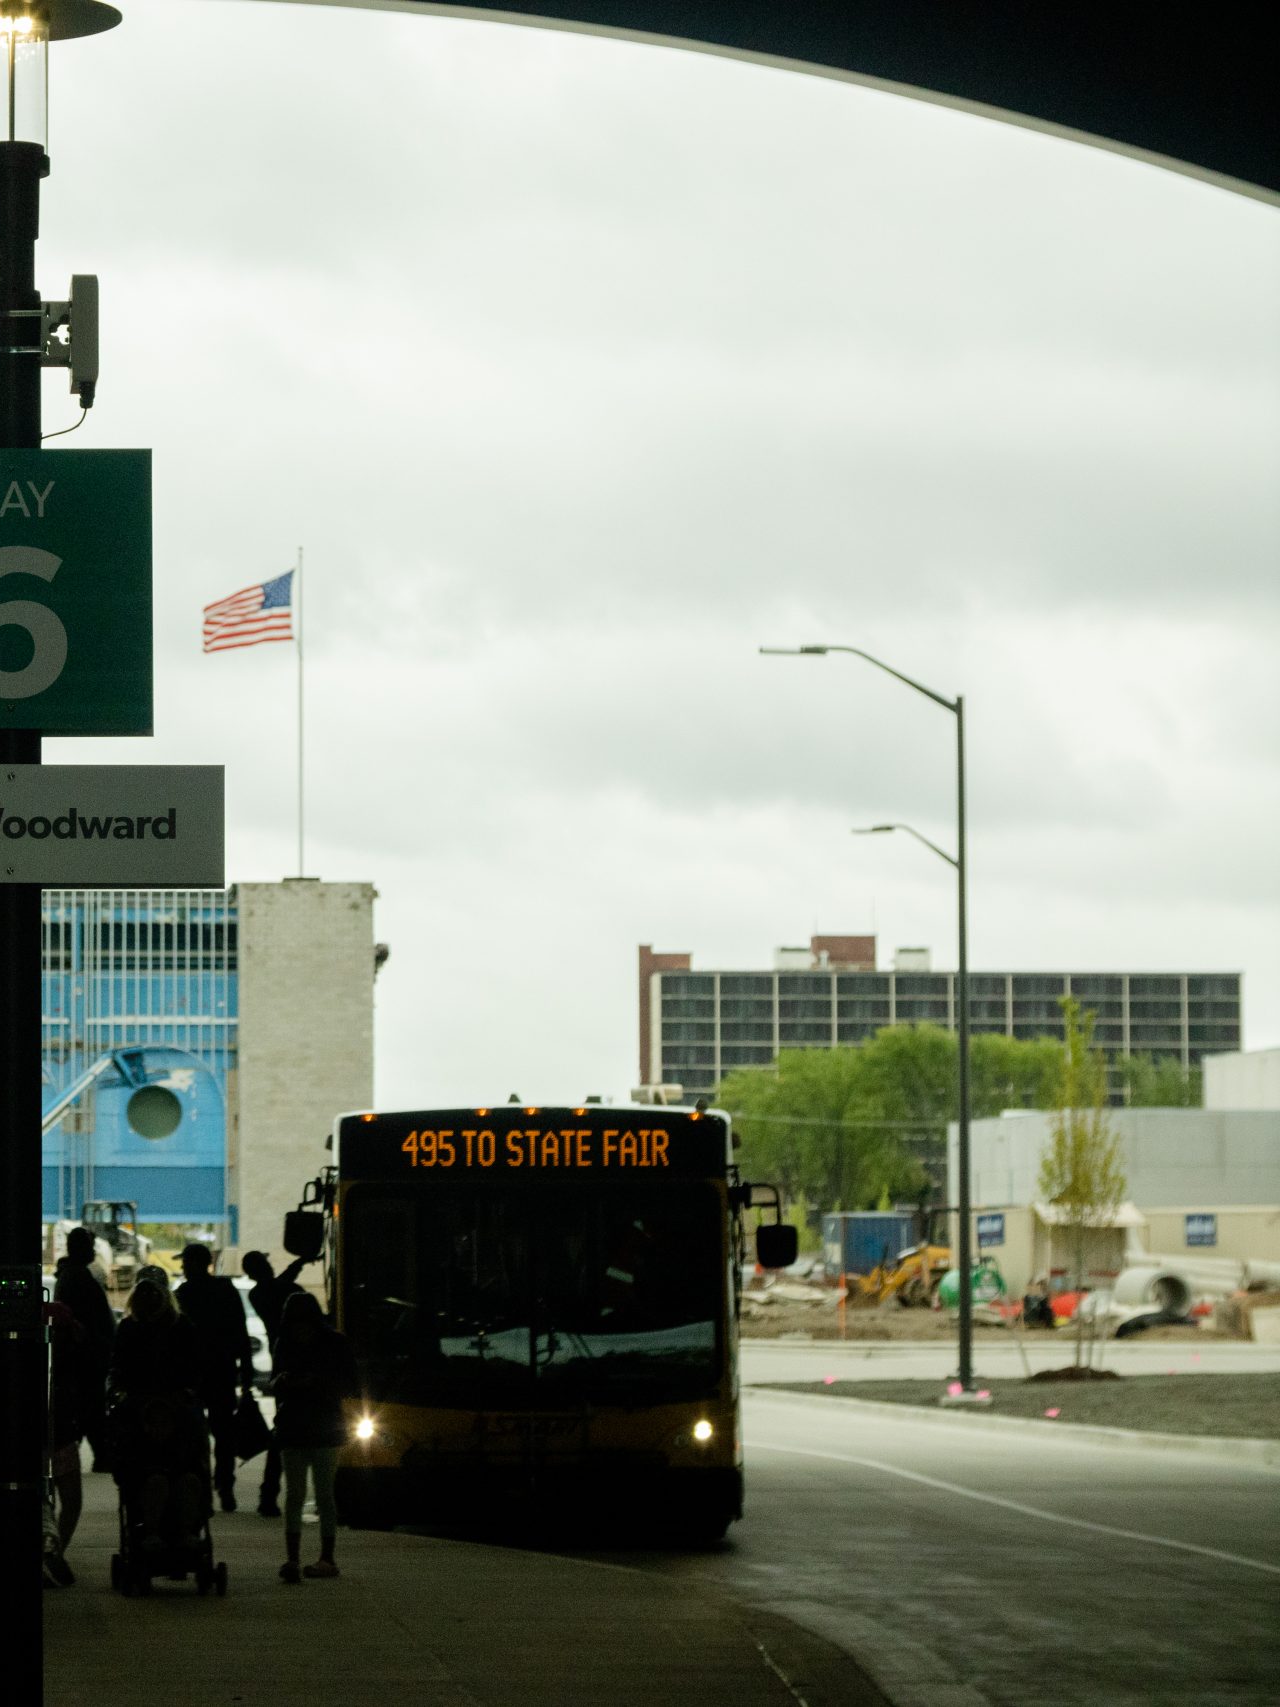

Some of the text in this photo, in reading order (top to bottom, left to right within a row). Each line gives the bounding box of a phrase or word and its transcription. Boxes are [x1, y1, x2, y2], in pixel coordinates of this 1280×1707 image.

[402, 1130, 669, 1166] 495 TO STATE FAIR
